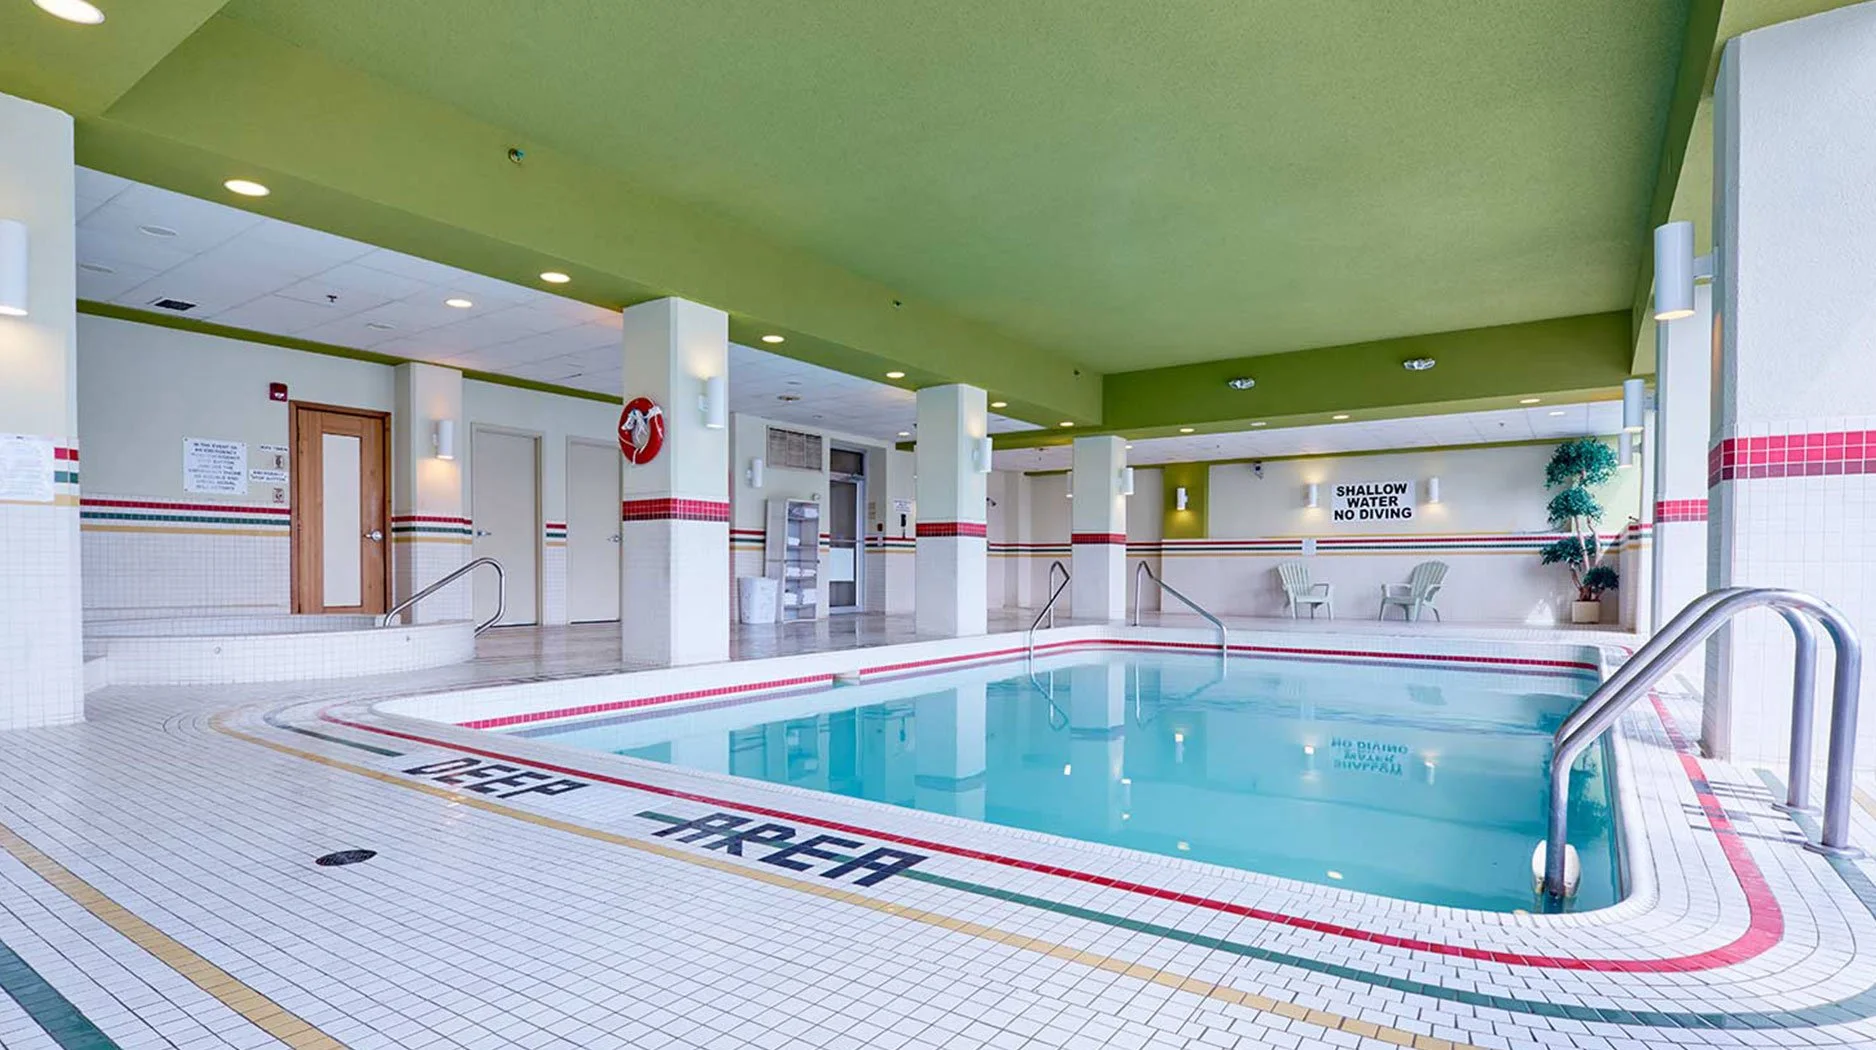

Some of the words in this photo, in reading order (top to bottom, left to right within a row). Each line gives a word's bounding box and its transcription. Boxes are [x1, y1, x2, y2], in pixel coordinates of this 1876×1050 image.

[1336, 483, 1407, 497] SHALLOW
[1347, 496, 1398, 508] WATER
[1334, 510, 1355, 520] NO
[1360, 507, 1412, 520] DIVING
[402, 757, 591, 799] DEEP
[652, 812, 929, 887] AREA
